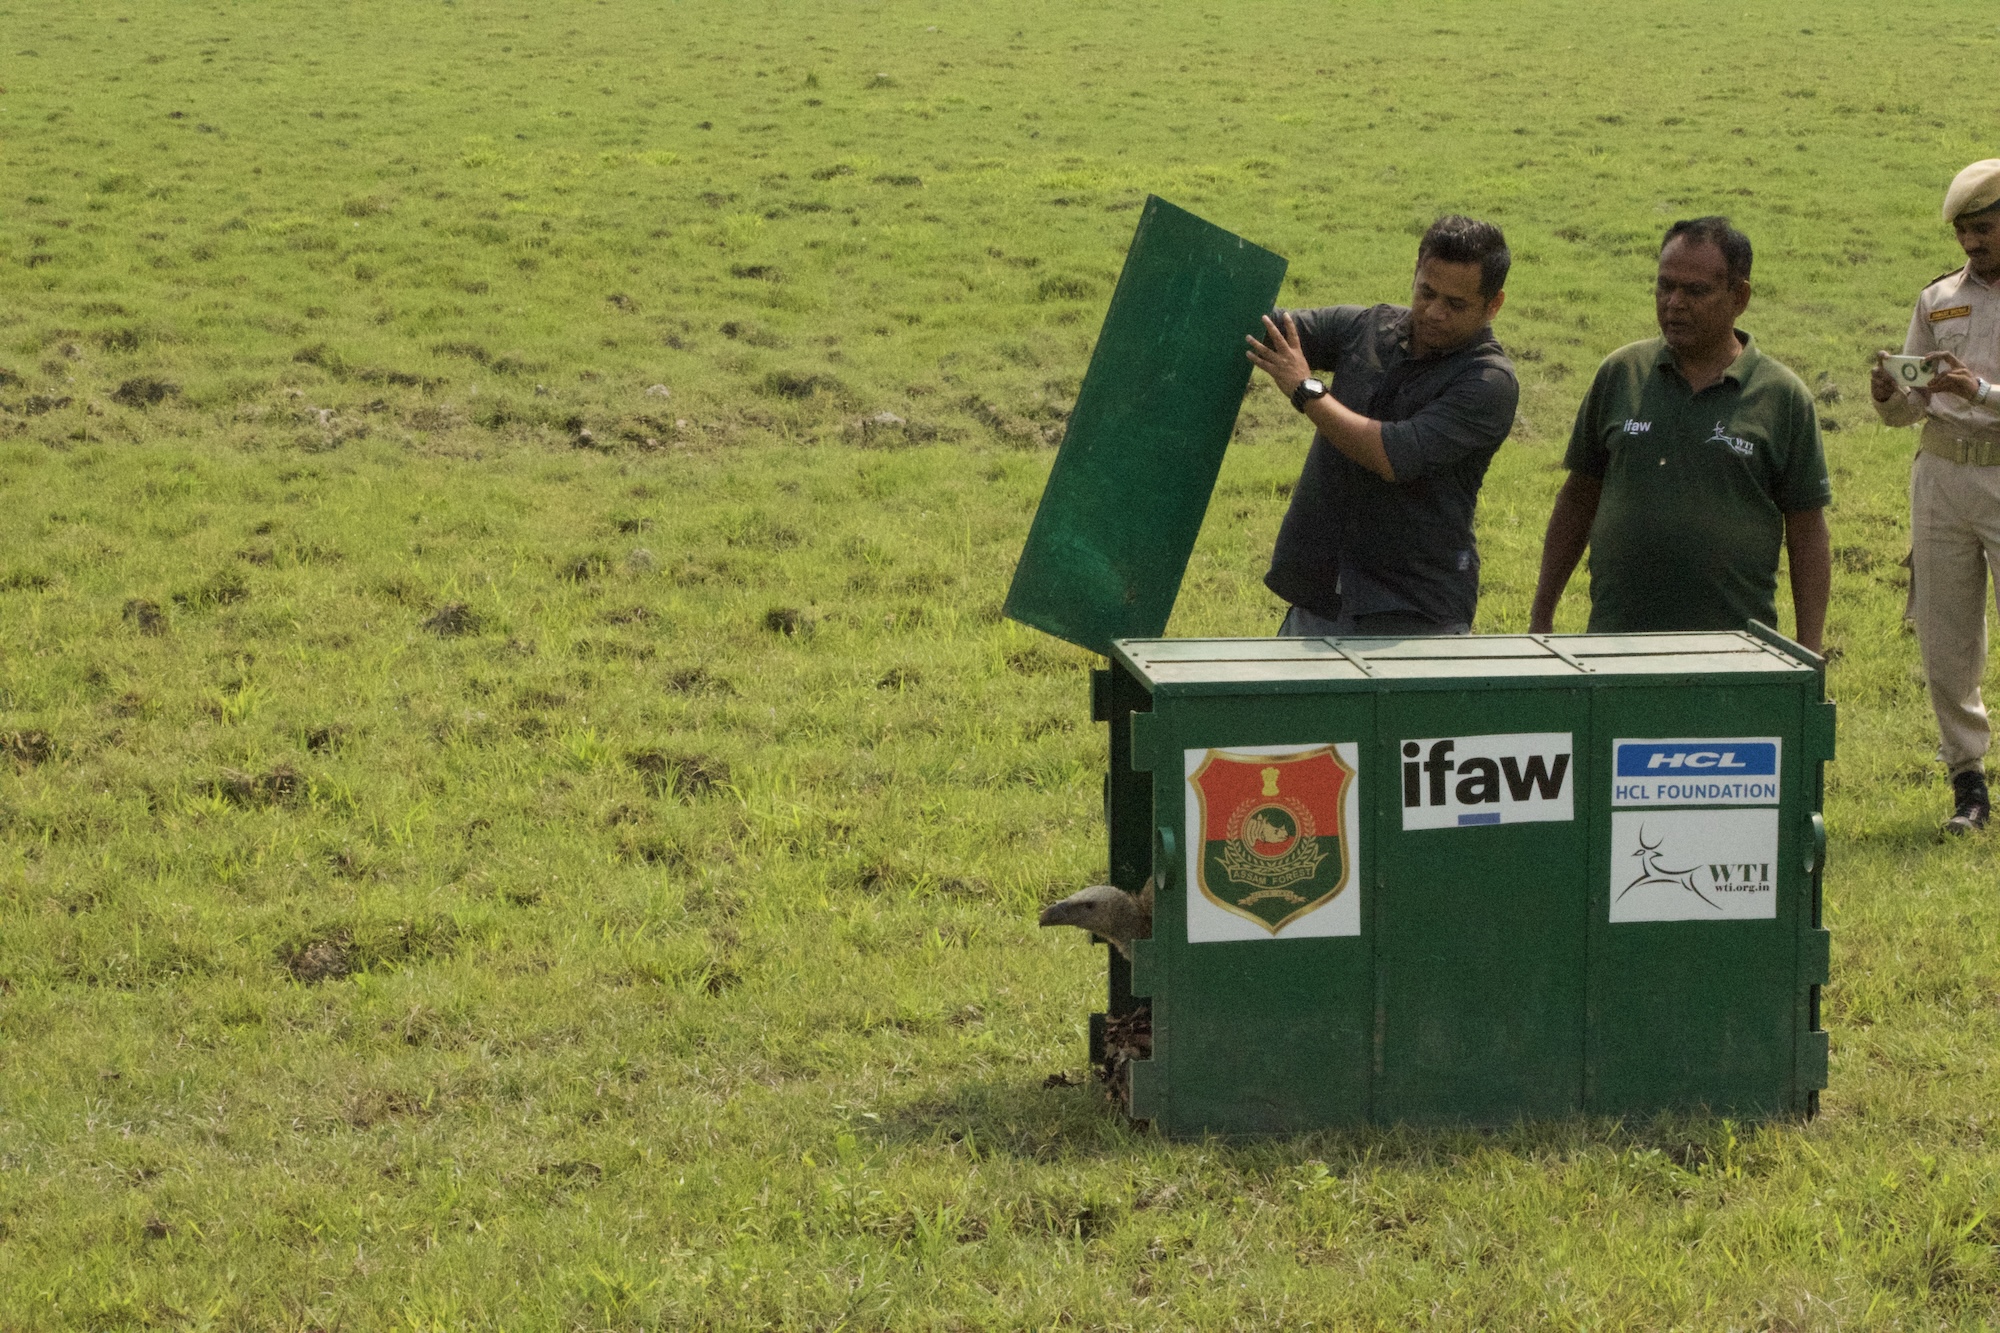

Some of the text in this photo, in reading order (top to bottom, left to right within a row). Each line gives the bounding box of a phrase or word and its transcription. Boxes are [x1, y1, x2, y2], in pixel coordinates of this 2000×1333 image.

[1623, 419, 1652, 432] ifaw
[1736, 437, 1754, 450] WTI
[1647, 752, 1746, 768] HCL
[1403, 740, 1571, 807] ifaw
[1616, 783, 1775, 799] HCL FOUNDATION
[1233, 868, 1311, 885] ASSAM FOREST
[1708, 863, 1769, 882] WTI
[1715, 883, 1770, 894] wti.org.in
